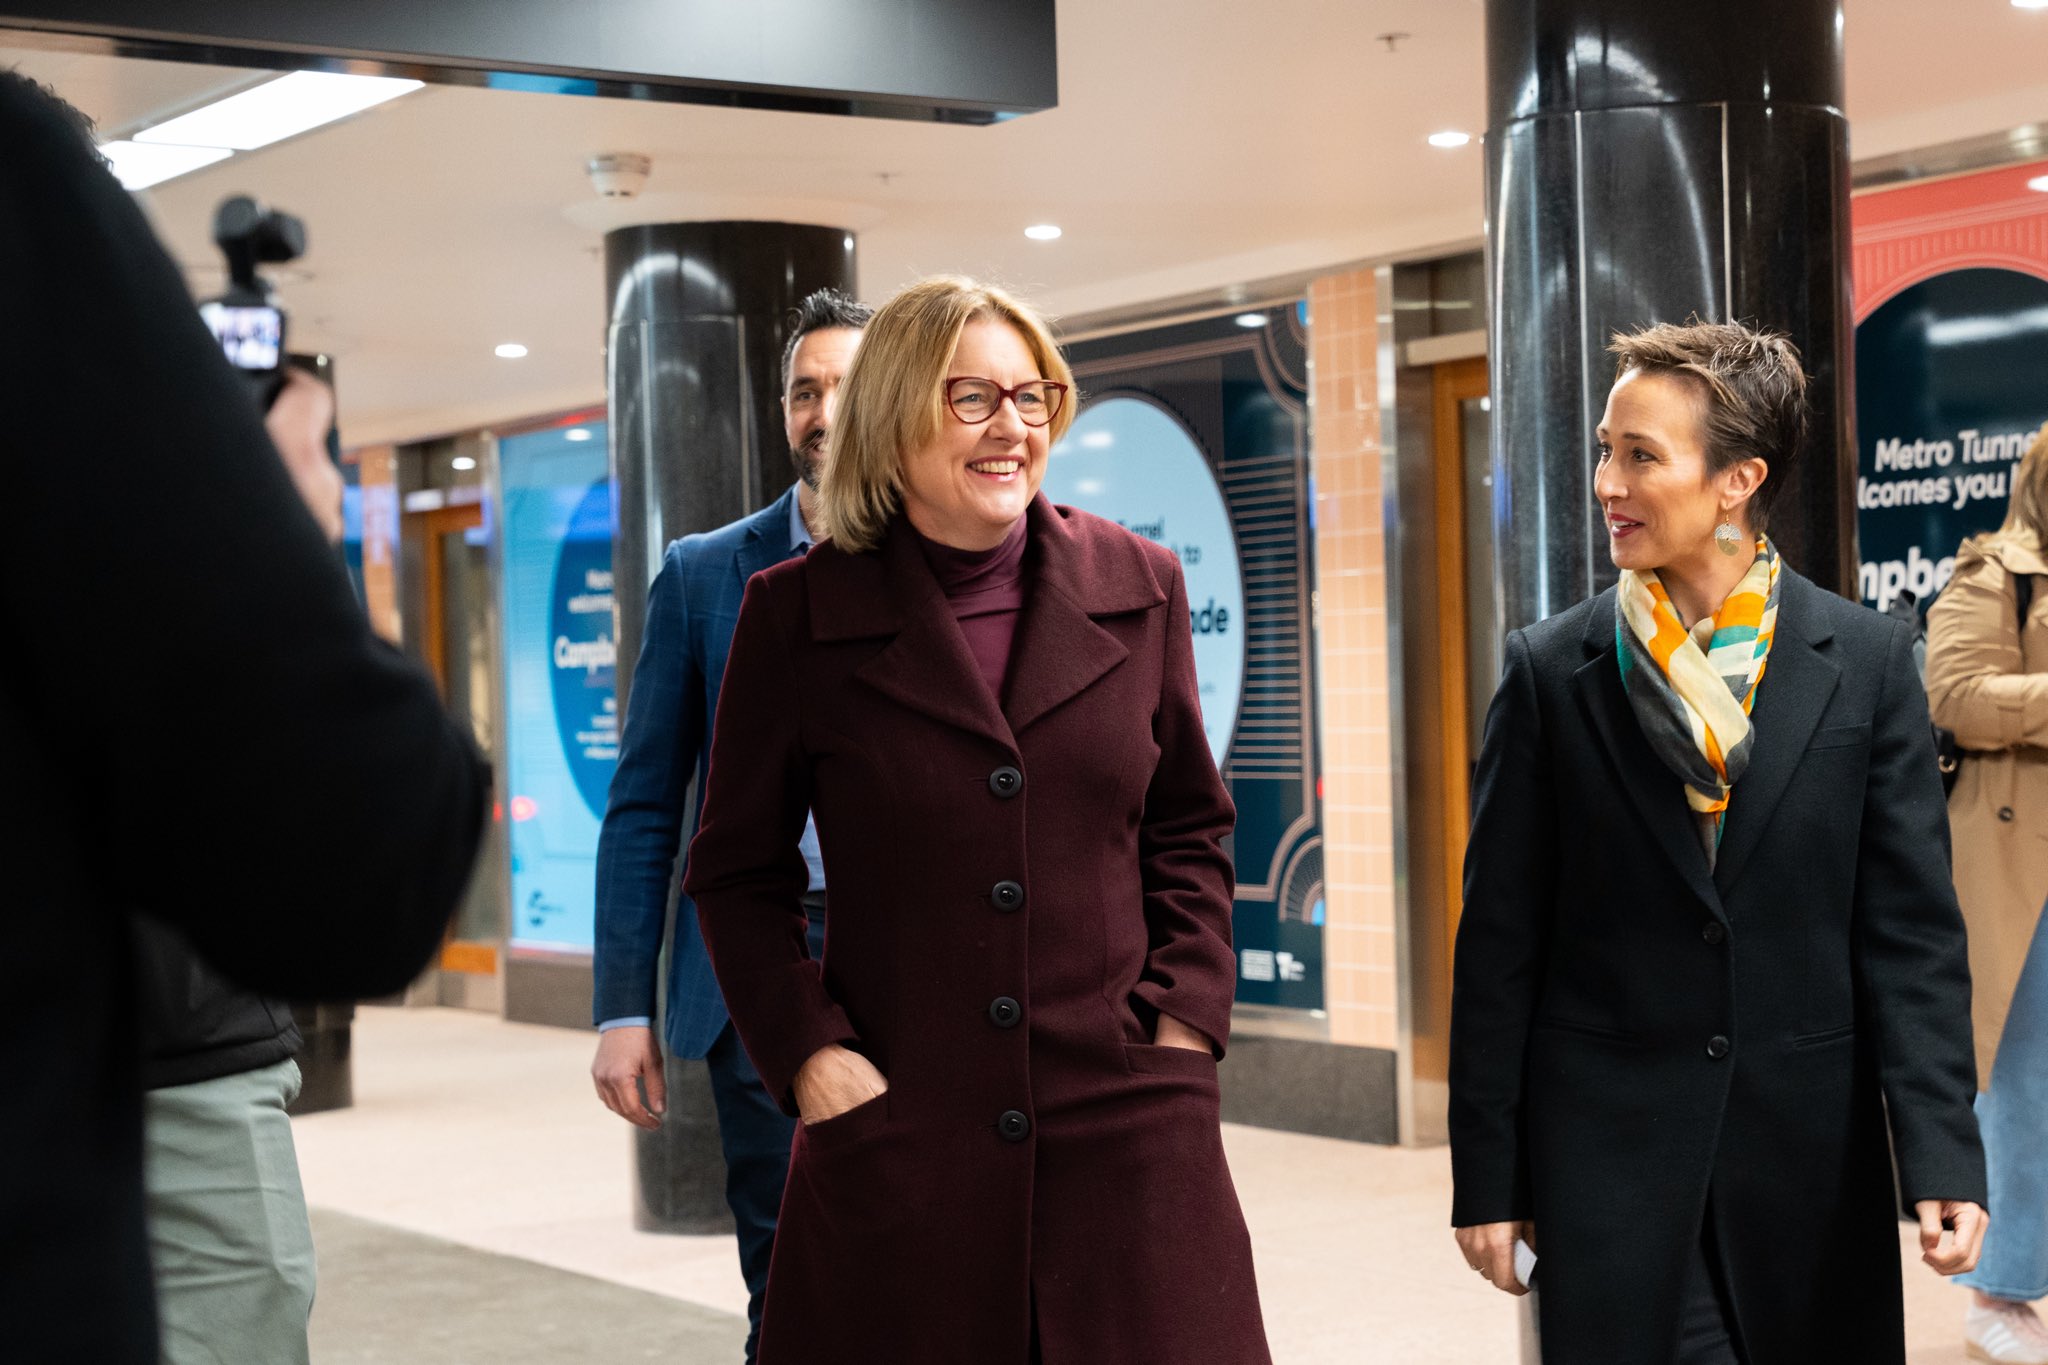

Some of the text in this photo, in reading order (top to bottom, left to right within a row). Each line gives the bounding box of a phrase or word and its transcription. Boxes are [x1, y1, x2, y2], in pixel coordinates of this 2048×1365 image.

[1875, 438, 1954, 472] Metro
[1858, 477, 1949, 509] lcomes
[1953, 472, 2006, 509] you
